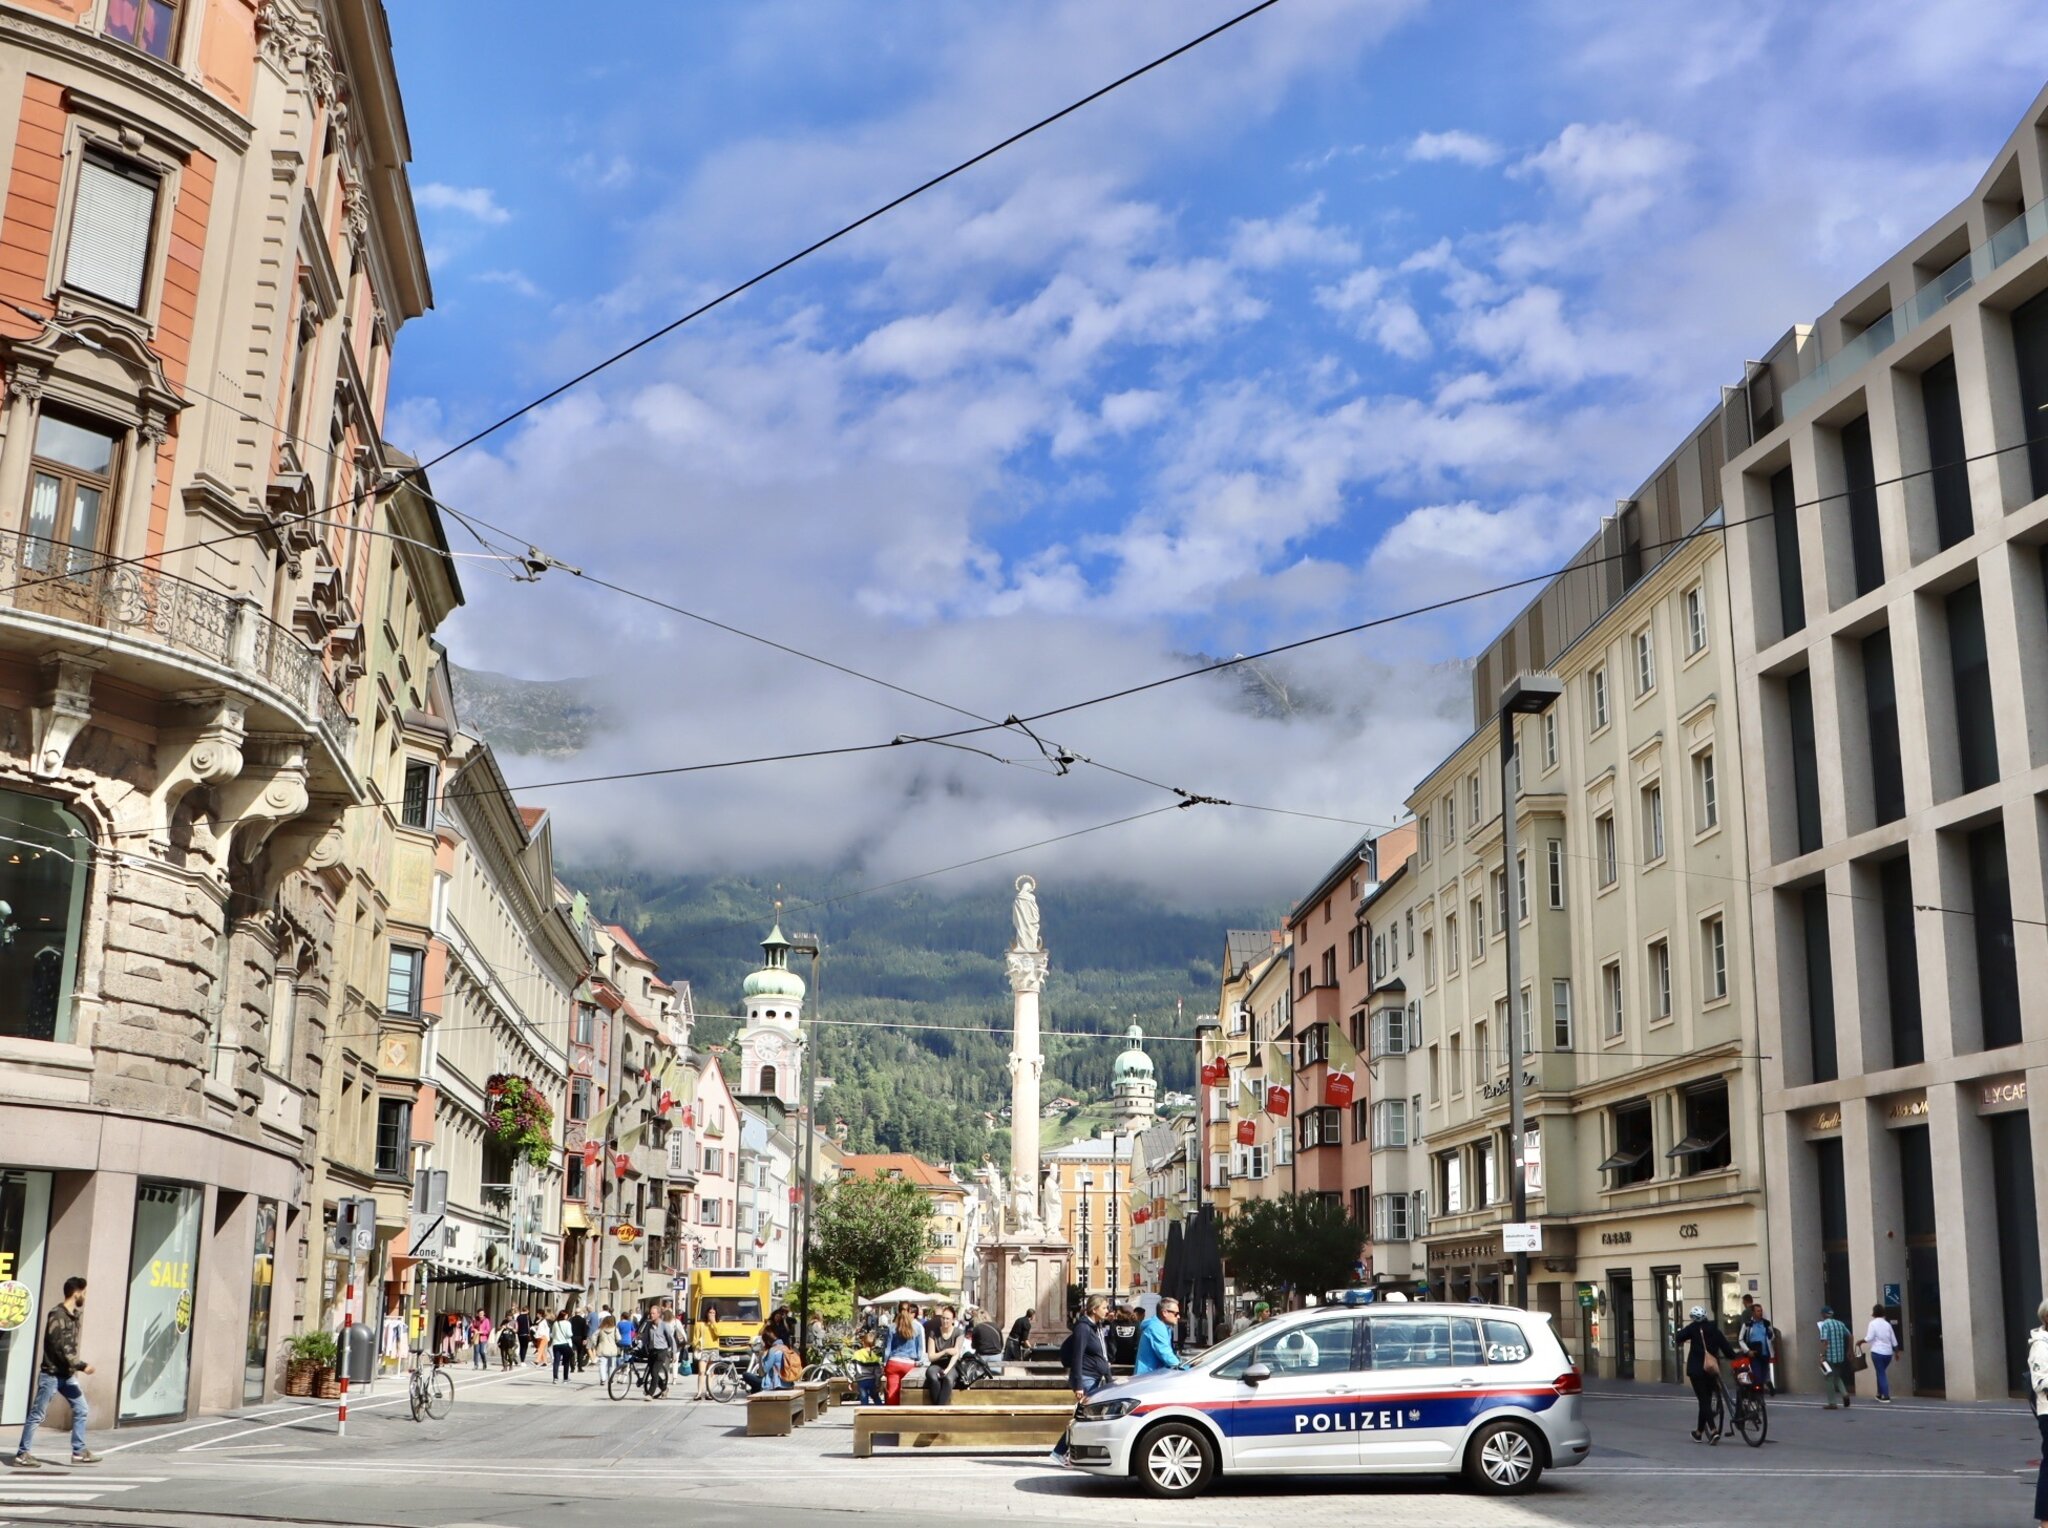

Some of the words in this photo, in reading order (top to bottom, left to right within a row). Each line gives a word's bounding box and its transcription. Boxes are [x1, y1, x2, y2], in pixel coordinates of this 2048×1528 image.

[417, 1222, 436, 1240] 30
[1679, 1224, 1699, 1239] COS
[150, 1259, 189, 1289] SALE
[1499, 1344, 1526, 1362] 133
[1295, 1409, 1404, 1433] POLIZEI
